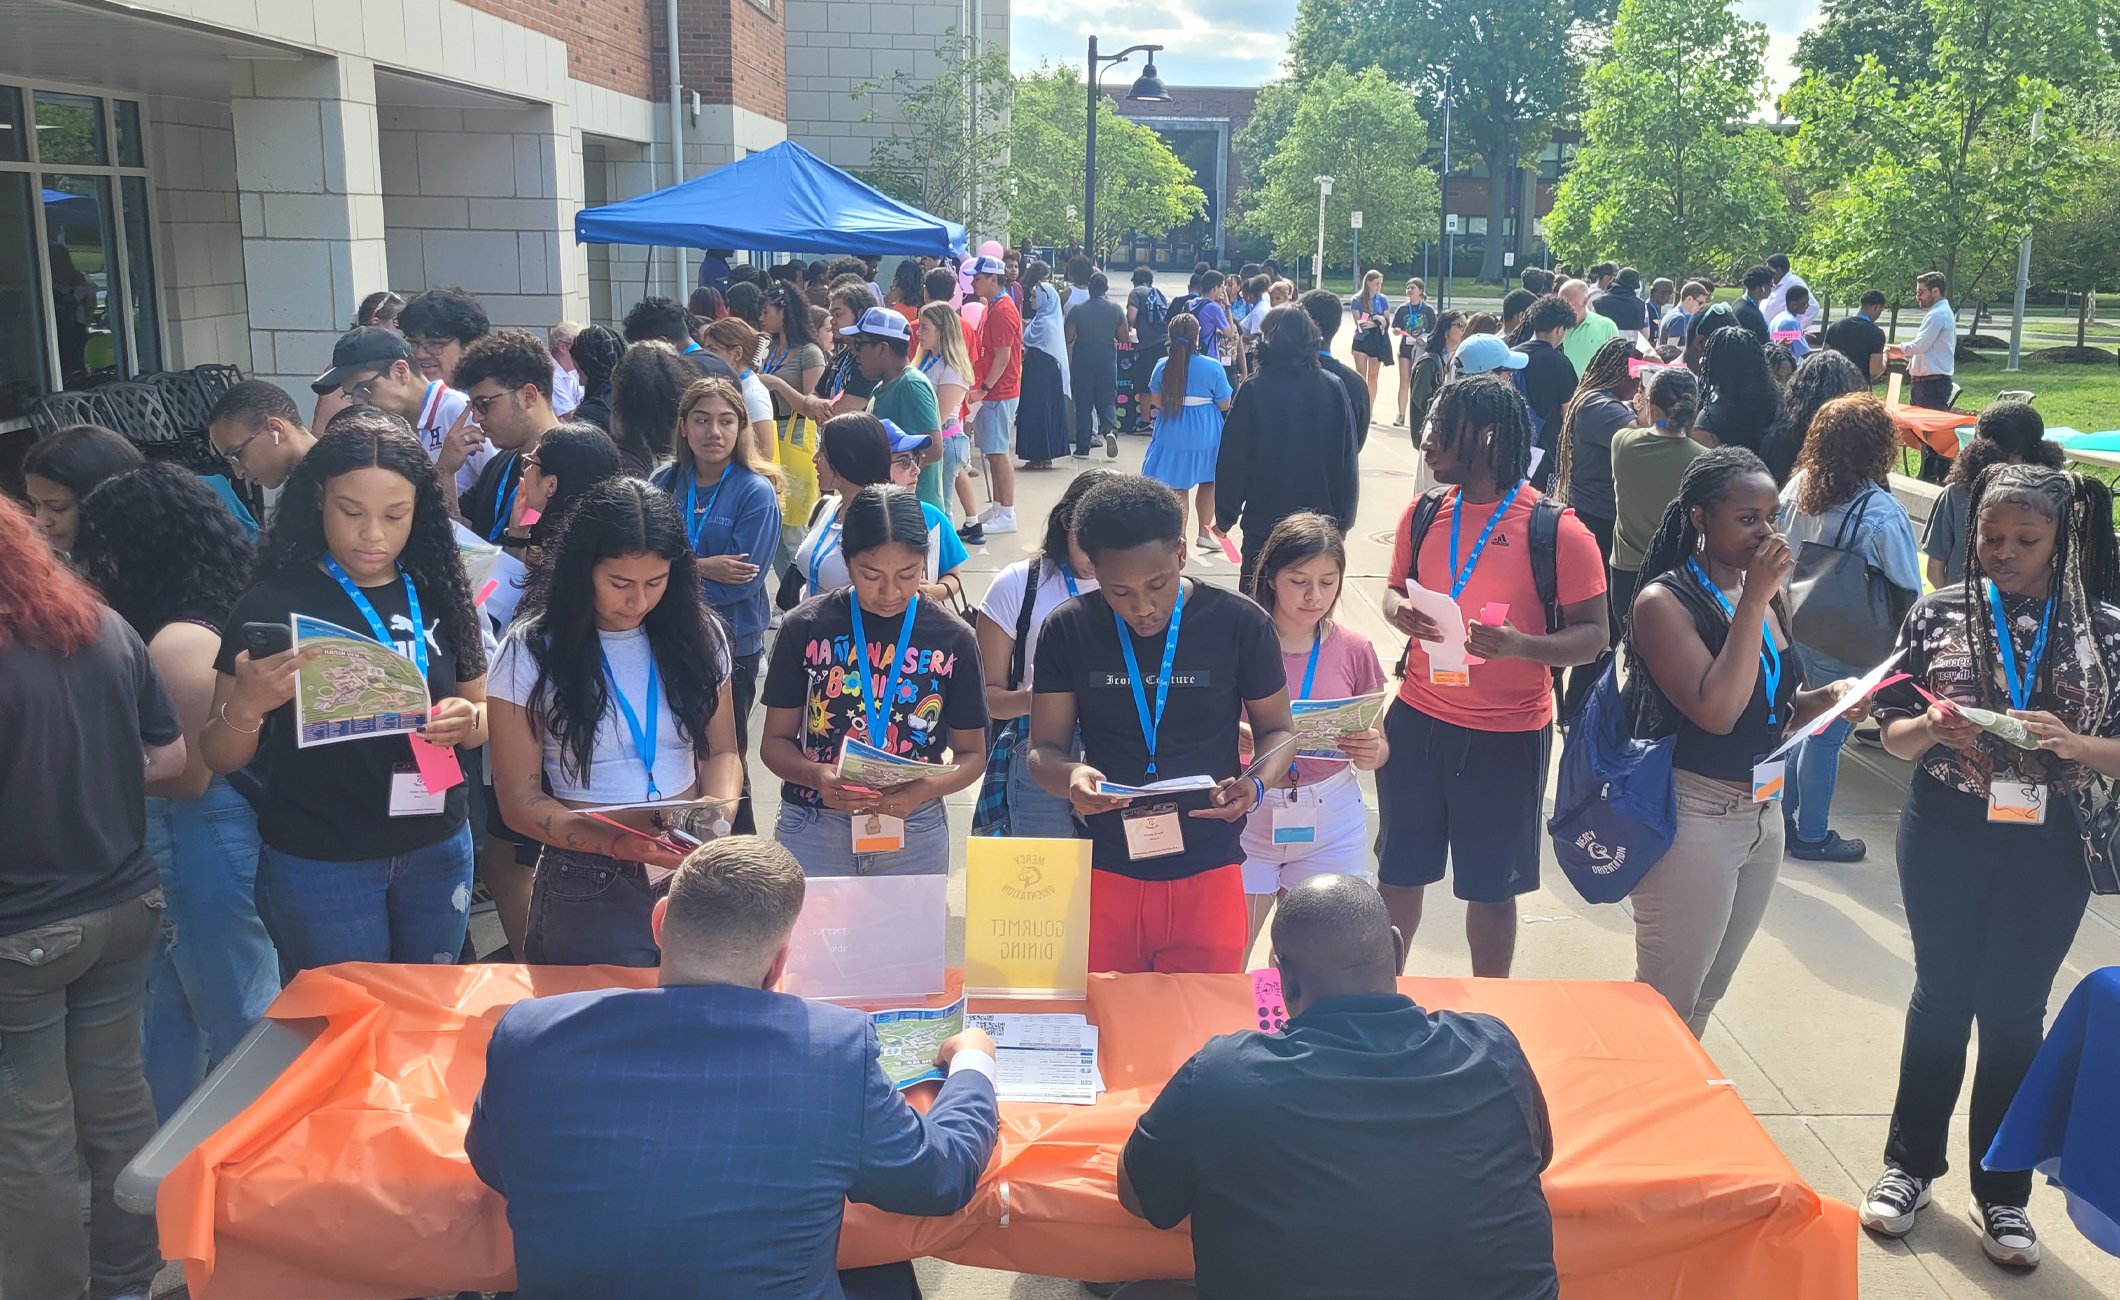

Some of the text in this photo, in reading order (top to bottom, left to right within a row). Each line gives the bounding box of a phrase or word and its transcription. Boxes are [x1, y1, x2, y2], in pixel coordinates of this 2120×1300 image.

[901, 647, 958, 679] SERÁ
[1106, 675, 1196, 685] Ico Coture
[1575, 830, 1597, 849] MERCY
[1592, 846, 1626, 875] ORIENTATION
